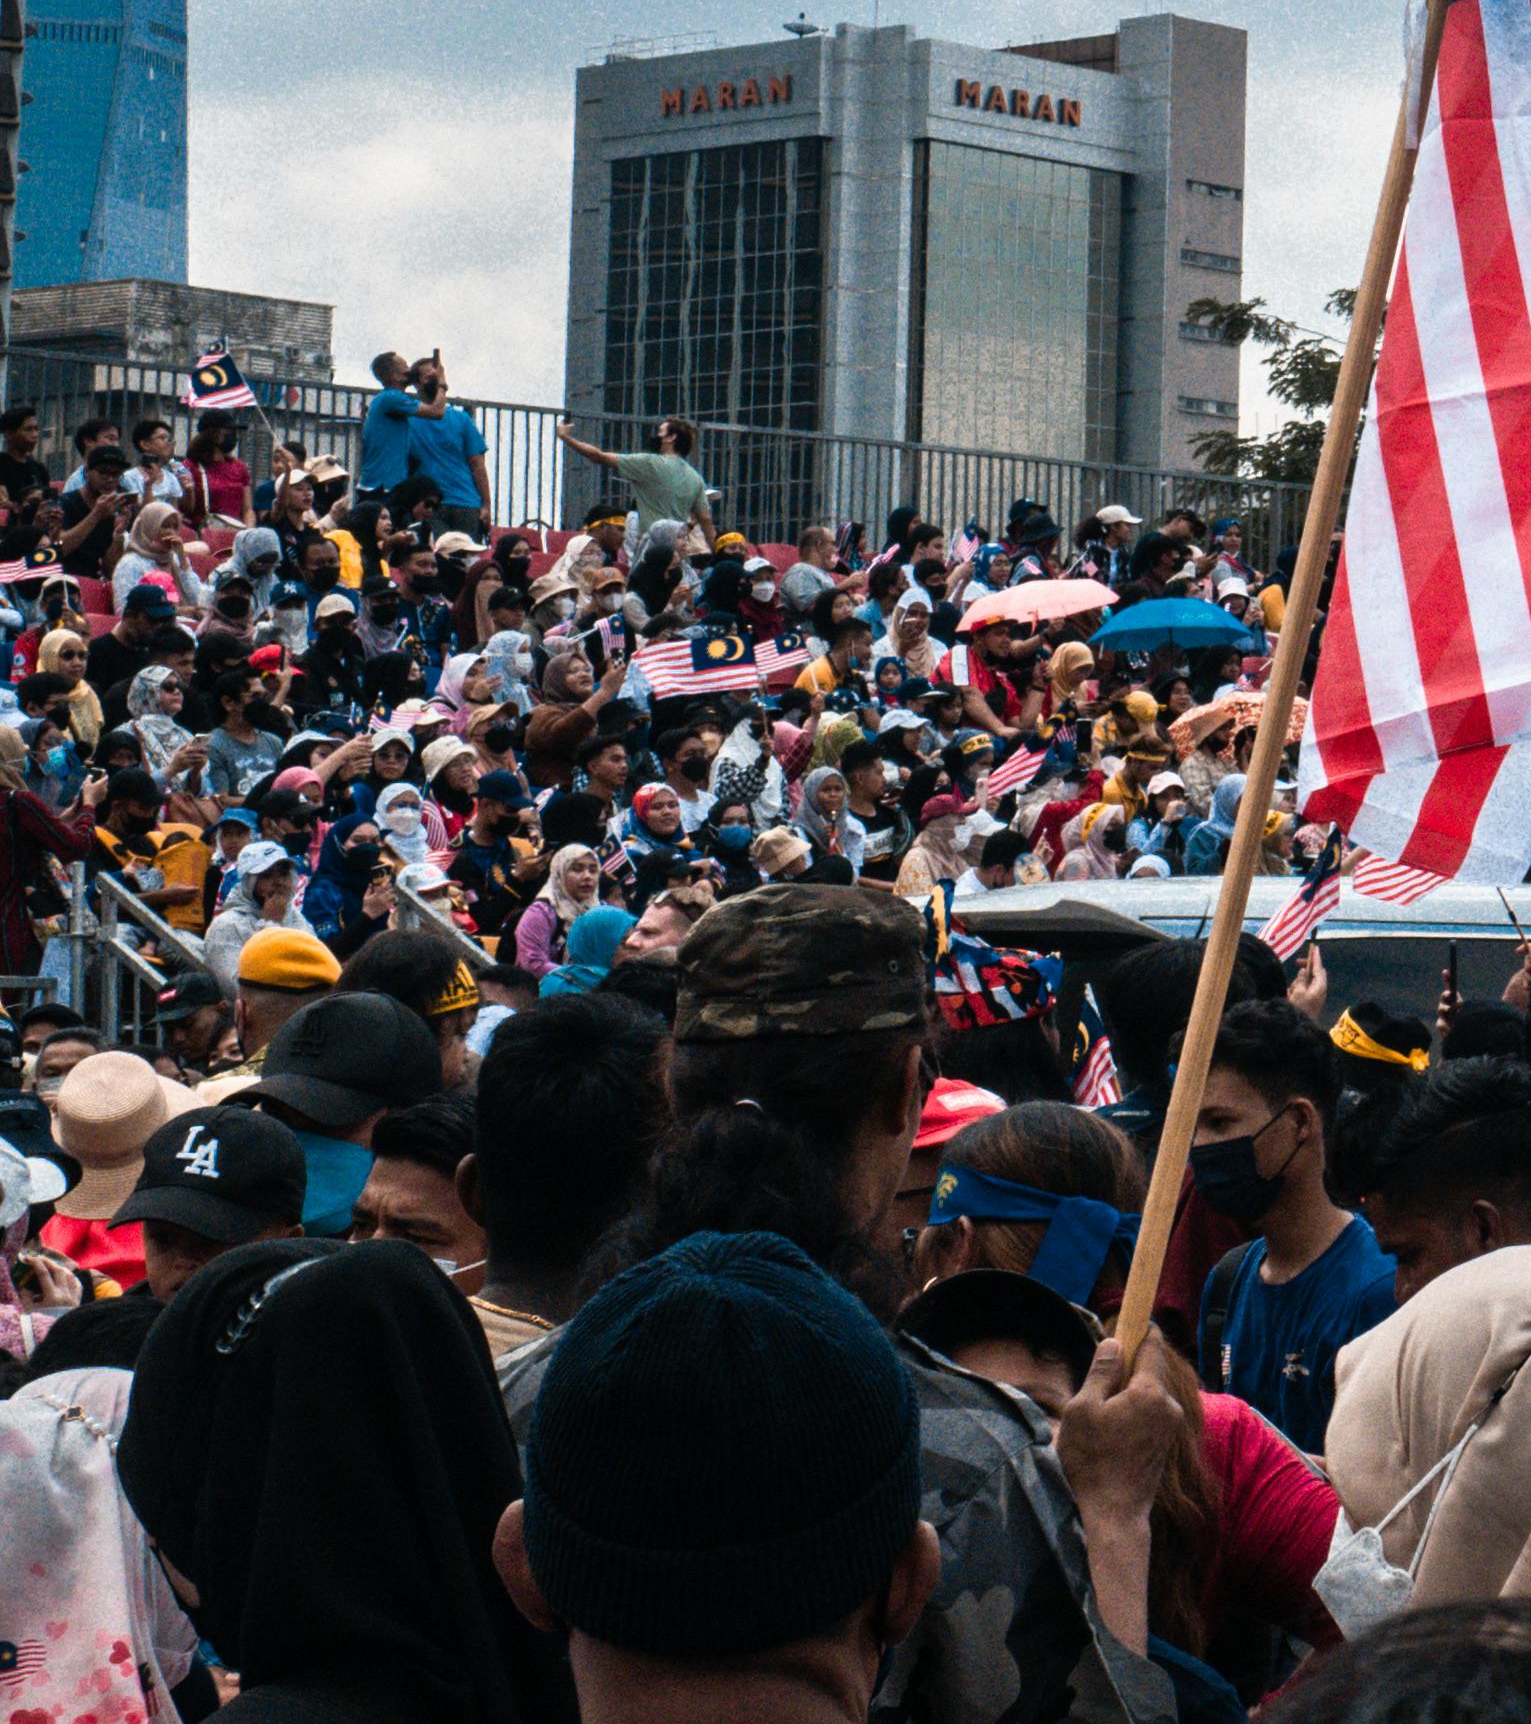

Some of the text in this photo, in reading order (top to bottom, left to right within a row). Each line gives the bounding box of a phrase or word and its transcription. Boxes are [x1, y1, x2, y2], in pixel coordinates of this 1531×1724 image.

[660, 75, 793, 117] MARAN
[956, 77, 1082, 127] MARAN
[175, 1124, 221, 1178] LA
